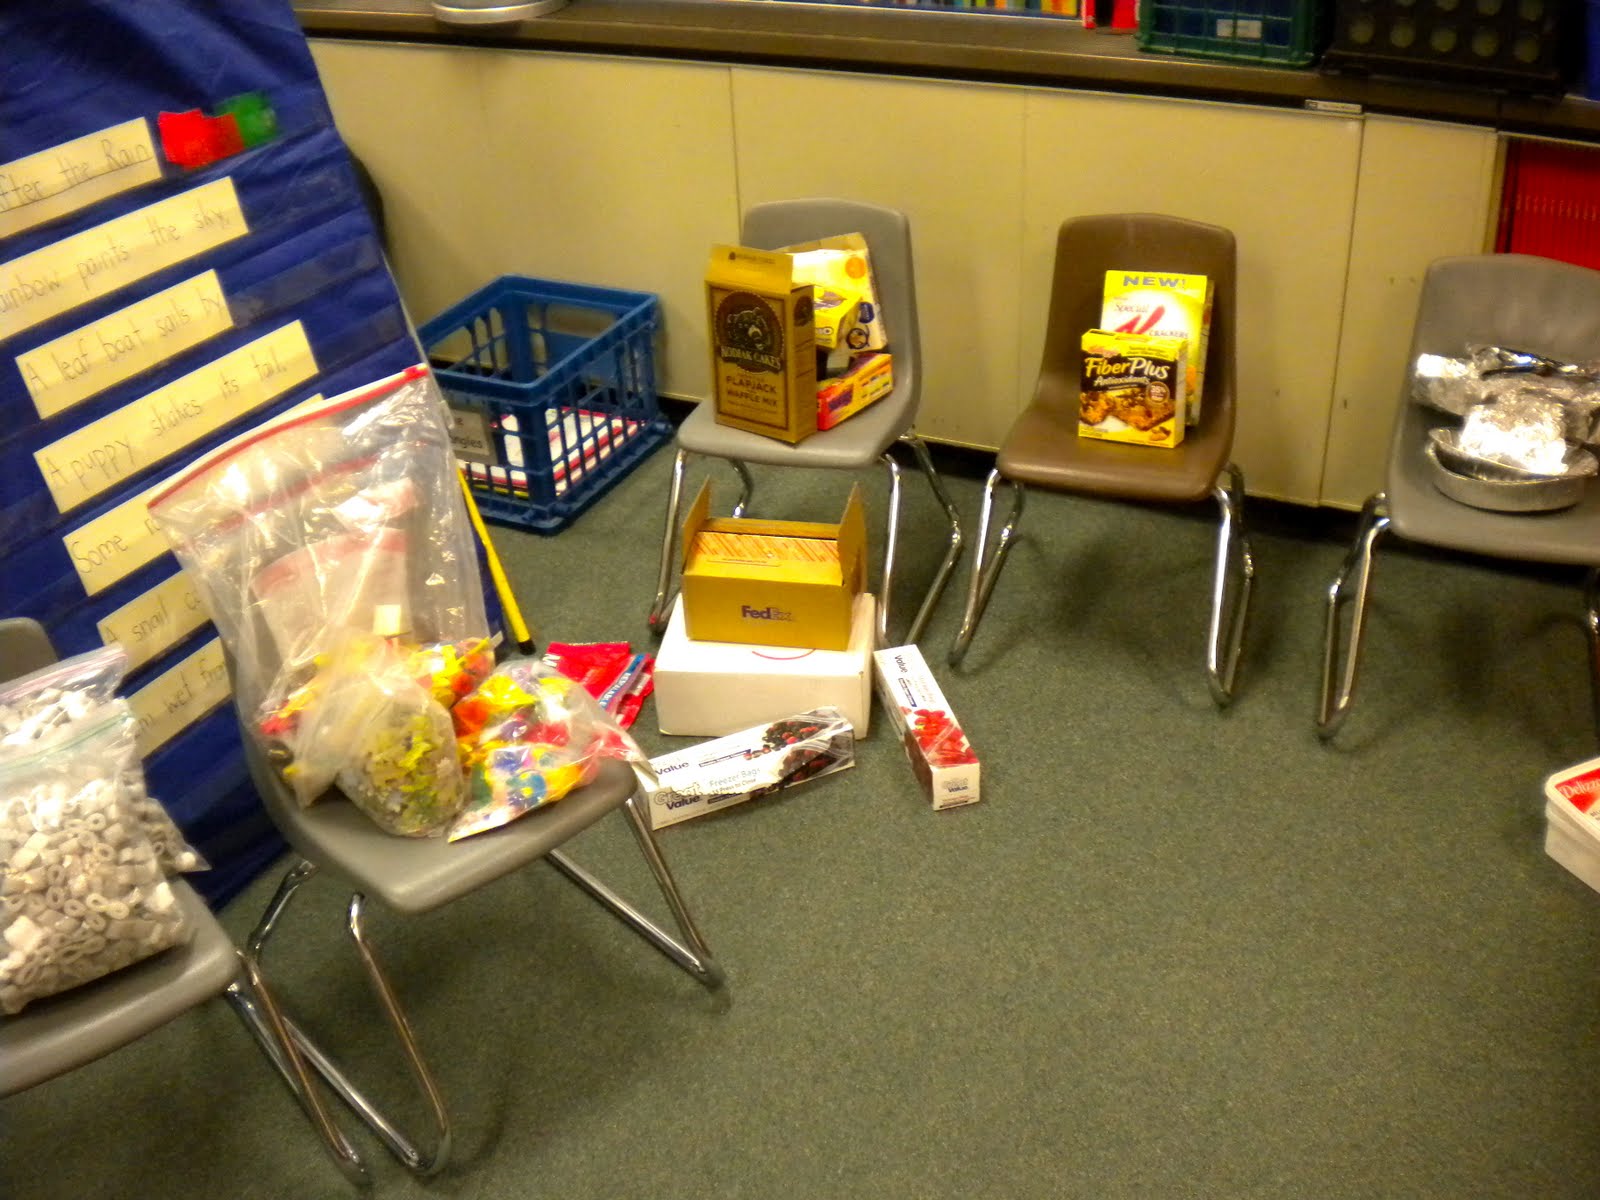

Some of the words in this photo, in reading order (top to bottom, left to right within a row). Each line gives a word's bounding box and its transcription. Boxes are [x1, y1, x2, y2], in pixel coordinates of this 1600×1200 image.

[56, 155, 90, 187] the
[100, 139, 150, 169] Rain
[77, 234, 129, 290] paints
[146, 215, 181, 247] the
[1123, 275, 1187, 288] NEW!
[26, 362, 49, 396] A
[51, 338, 88, 381] leaf
[97, 318, 144, 361] boat
[155, 297, 191, 337] sails
[45, 456, 70, 487] A
[71, 434, 136, 492] puppy
[218, 369, 239, 400] its
[71, 536, 128, 574] Some
[131, 594, 169, 643] snail
[741, 605, 793, 622] FedEx
[895, 654, 908, 674] Value
[655, 761, 690, 776] Value
[709, 774, 740, 788] Freezer
[653, 781, 702, 806] Great
[666, 794, 702, 810] Value
